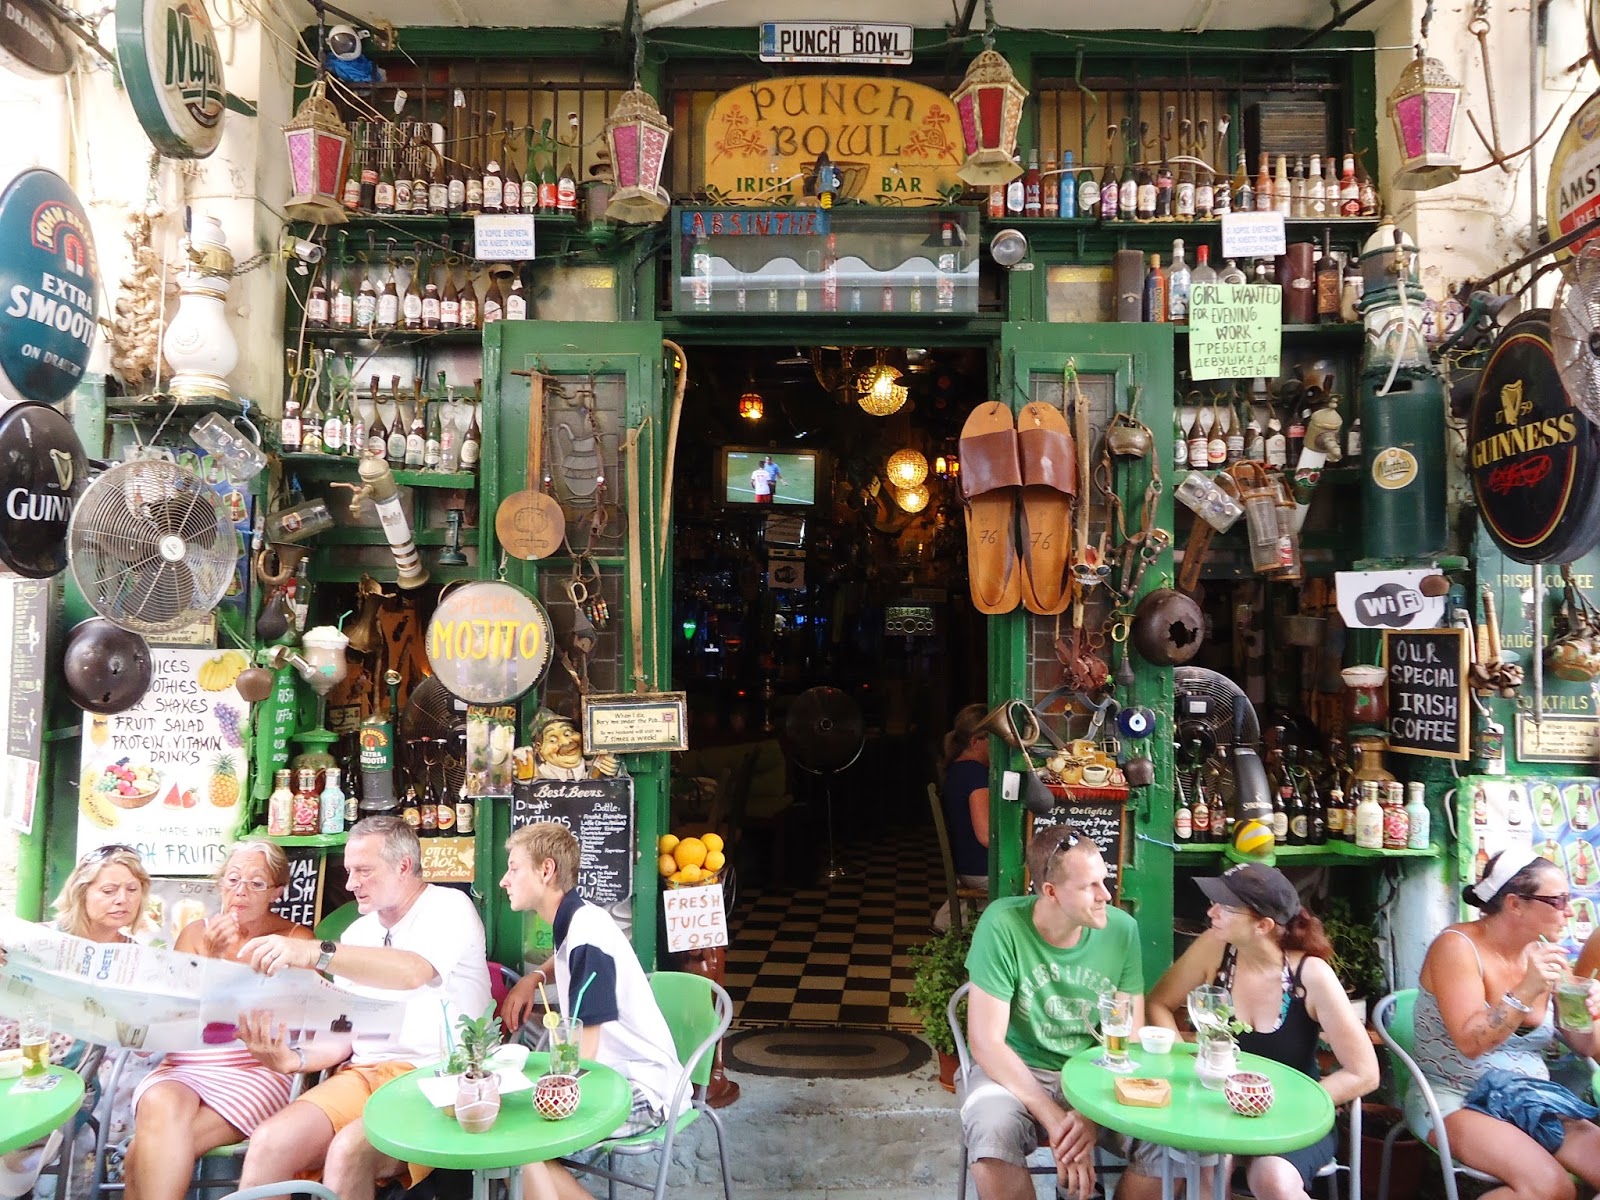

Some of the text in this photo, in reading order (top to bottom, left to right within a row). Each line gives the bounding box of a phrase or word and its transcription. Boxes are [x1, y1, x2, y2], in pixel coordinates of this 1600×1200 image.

[780, 30, 904, 56] PUNCH BOWL
[749, 81, 915, 122] PUNCH
[769, 124, 905, 157] BOWL
[736, 177, 793, 193] IRISH
[882, 177, 922, 193] BAR
[690, 211, 818, 236] ABSINTHE
[41, 272, 94, 315] EXTRA
[1192, 285, 1281, 305] GIRL WANTED
[5, 284, 98, 349] SMOOTH
[1192, 306, 1258, 324] FOR EVENING
[1215, 326, 1252, 340] WORK
[21, 343, 41, 360] ON
[1194, 342, 1267, 355] ТРЕБУЕТСЯ
[1194, 354, 1279, 368] ДЕВУШКА ДЛЯ
[1218, 366, 1267, 378] РАБОТЫ
[1471, 412, 1577, 469] GUINNESS
[6, 487, 74, 522] GUINN
[979, 530, 998, 544] 76
[1030, 532, 1053, 550] 76
[1497, 574, 1533, 588] IRISH
[431, 618, 541, 661] MOJITO
[1500, 634, 1550, 648] RAUGT
[1397, 640, 1441, 664] OUR
[154, 659, 190, 675] ICES
[1391, 664, 1457, 688] SPECIAL
[148, 677, 197, 694] OTHIES
[155, 697, 208, 715] SHAKES
[1400, 692, 1457, 719] IRISH
[1515, 695, 1589, 710] COKTAILS
[115, 715, 204, 732] FRUIT SALAD
[1391, 717, 1456, 742] COFFEE
[112, 734, 222, 751] PROTEIN VITAMIN
[150, 750, 201, 765] DRINKS
[533, 783, 606, 799] Best Beers
[1069, 806, 1114, 817] Delights
[164, 844, 227, 865] FRUITS
[667, 894, 720, 911] FRESH
[669, 911, 723, 932] JUICE
[81, 945, 95, 976] CRETE
[97, 948, 114, 980] CRETE
